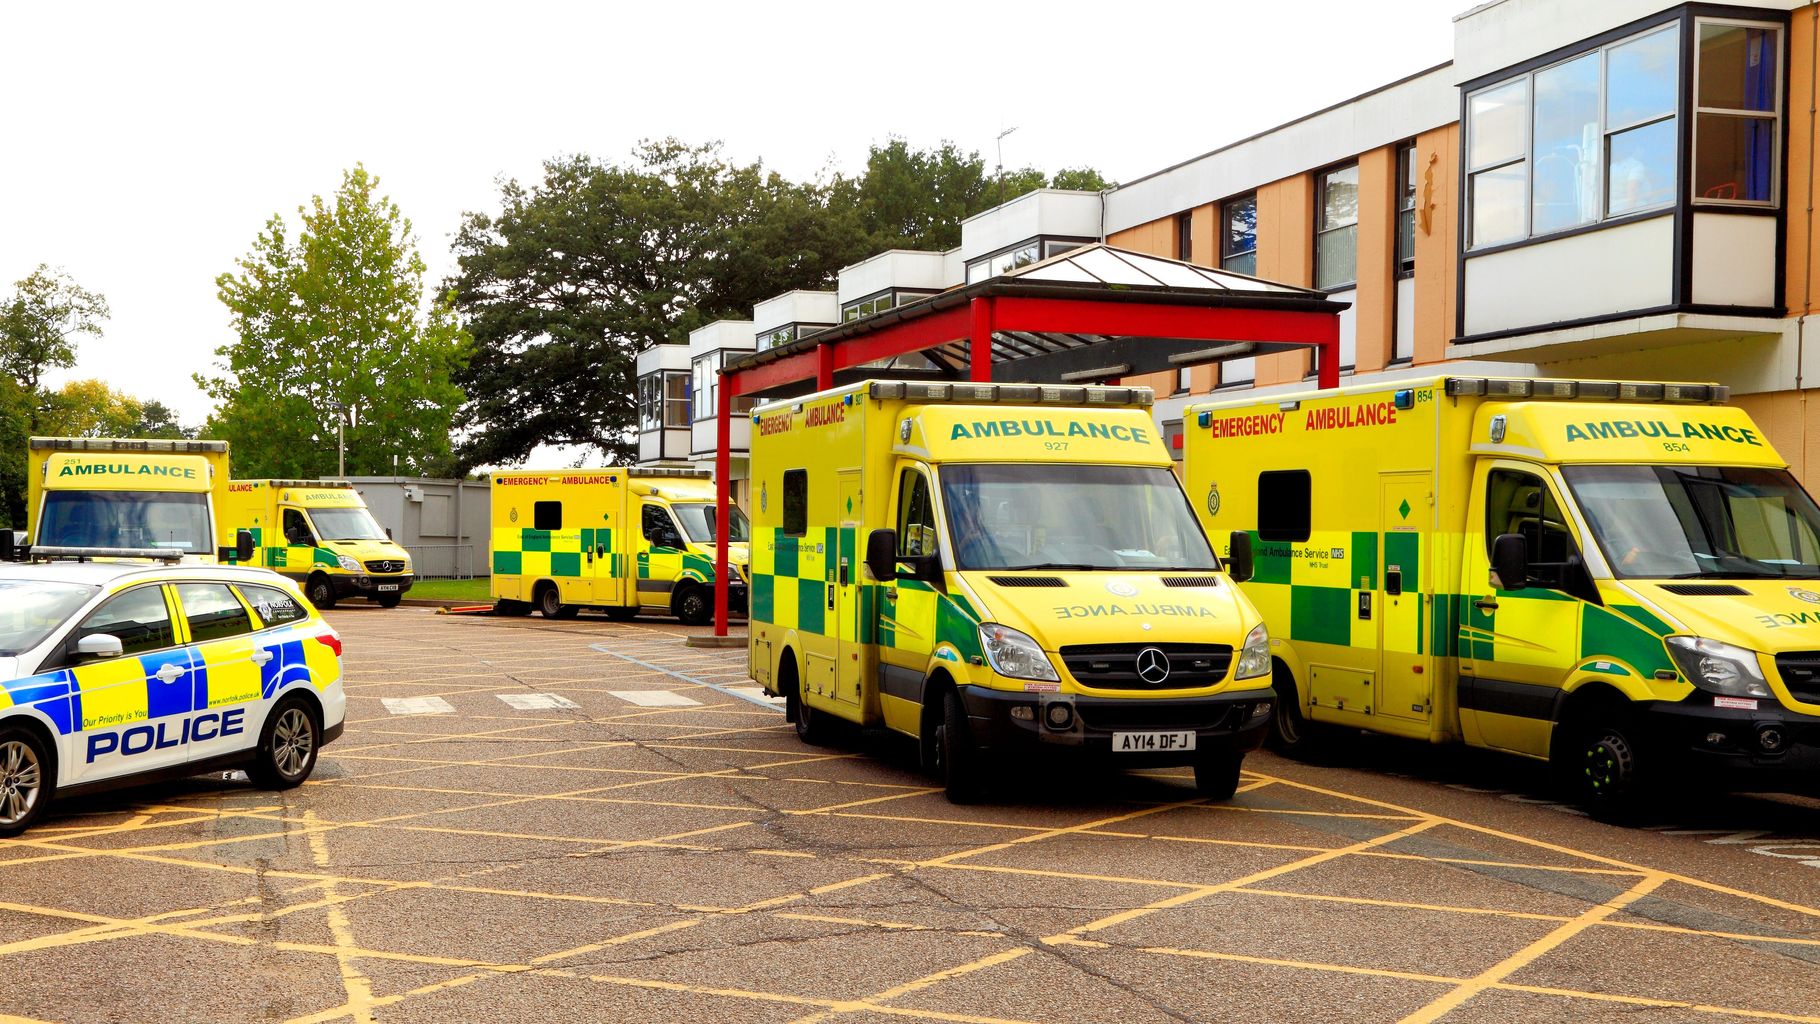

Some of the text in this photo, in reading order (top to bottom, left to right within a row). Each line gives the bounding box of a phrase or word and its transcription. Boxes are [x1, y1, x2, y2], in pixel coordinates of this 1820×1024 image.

[1417, 389, 1433, 403] 854
[760, 401, 845, 437] EMERGENCY AMBULANCE
[1212, 401, 1397, 438] EMERGENCY AMBULANCE
[950, 420, 1151, 445] AMBULANCE
[1565, 420, 1763, 447] AMBULANCE
[1044, 442, 1069, 451] 927
[1663, 443, 1690, 452] 854
[58, 464, 197, 479] AMBULANCE
[228, 483, 253, 492] ULANCE
[503, 477, 549, 486] EMERGENCY
[561, 475, 610, 485] AMBULANCE
[1304, 547, 1329, 560] Service
[1331, 548, 1344, 559] NHS
[208, 691, 260, 706] www.norfolk.police.uk
[83, 709, 148, 728] Our Priority is You
[86, 708, 245, 764] POLICE
[1122, 734, 1188, 750] AY14 DFJ
